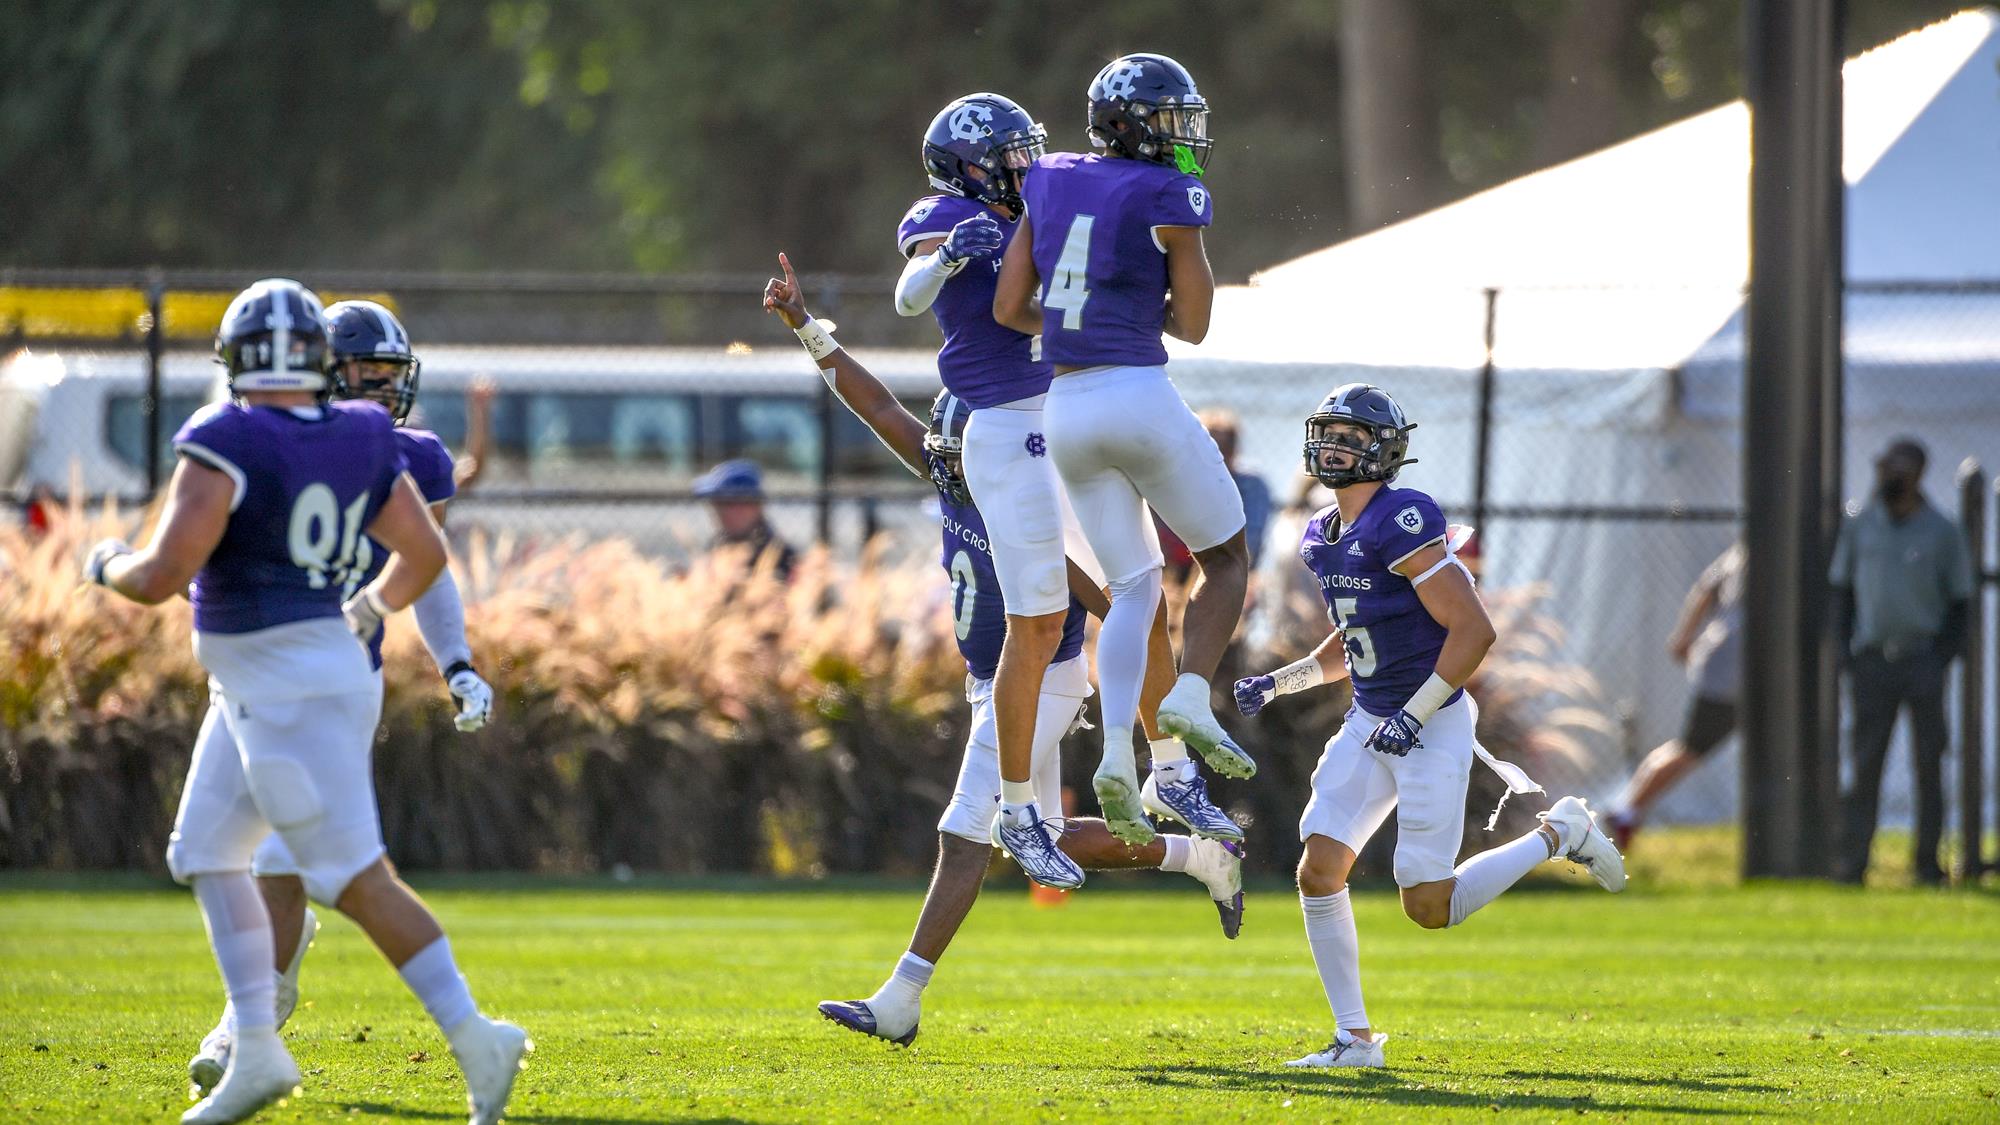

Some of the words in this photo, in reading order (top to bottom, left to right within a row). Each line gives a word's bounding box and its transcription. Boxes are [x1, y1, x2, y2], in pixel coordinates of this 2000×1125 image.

[1044, 213, 1096, 330] 4
[943, 514, 962, 536] OLY
[1331, 574, 1372, 590] CROSS
[1327, 597, 1377, 678] 5
[1390, 718, 1406, 740] adidas
